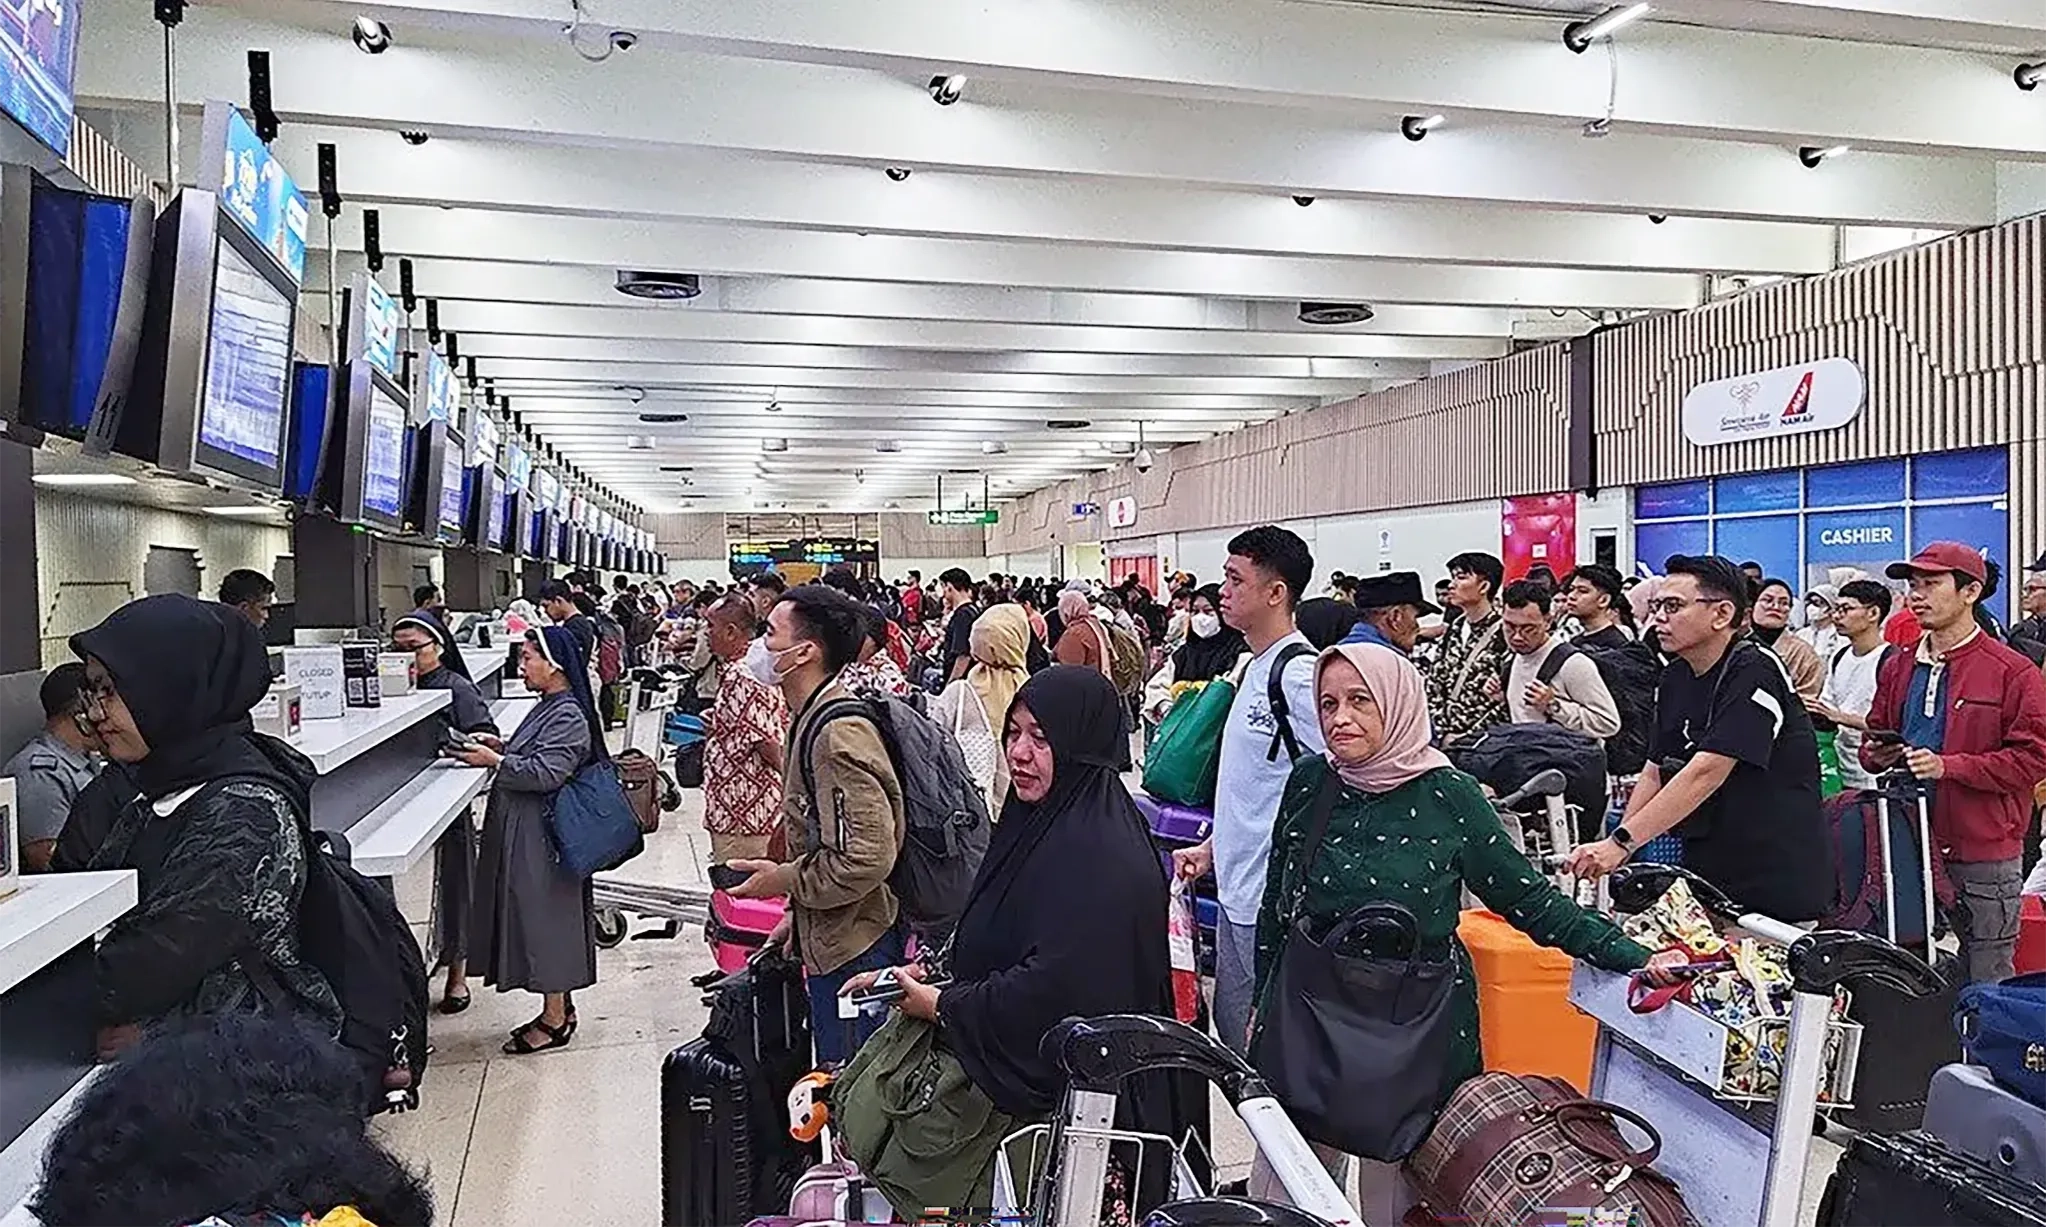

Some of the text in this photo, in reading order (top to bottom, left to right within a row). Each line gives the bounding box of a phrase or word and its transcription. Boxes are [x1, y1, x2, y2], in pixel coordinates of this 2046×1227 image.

[1780, 415, 1801, 427] NAM
[1820, 526, 1893, 545] CASHIER
[298, 667, 334, 678] CLOSED
